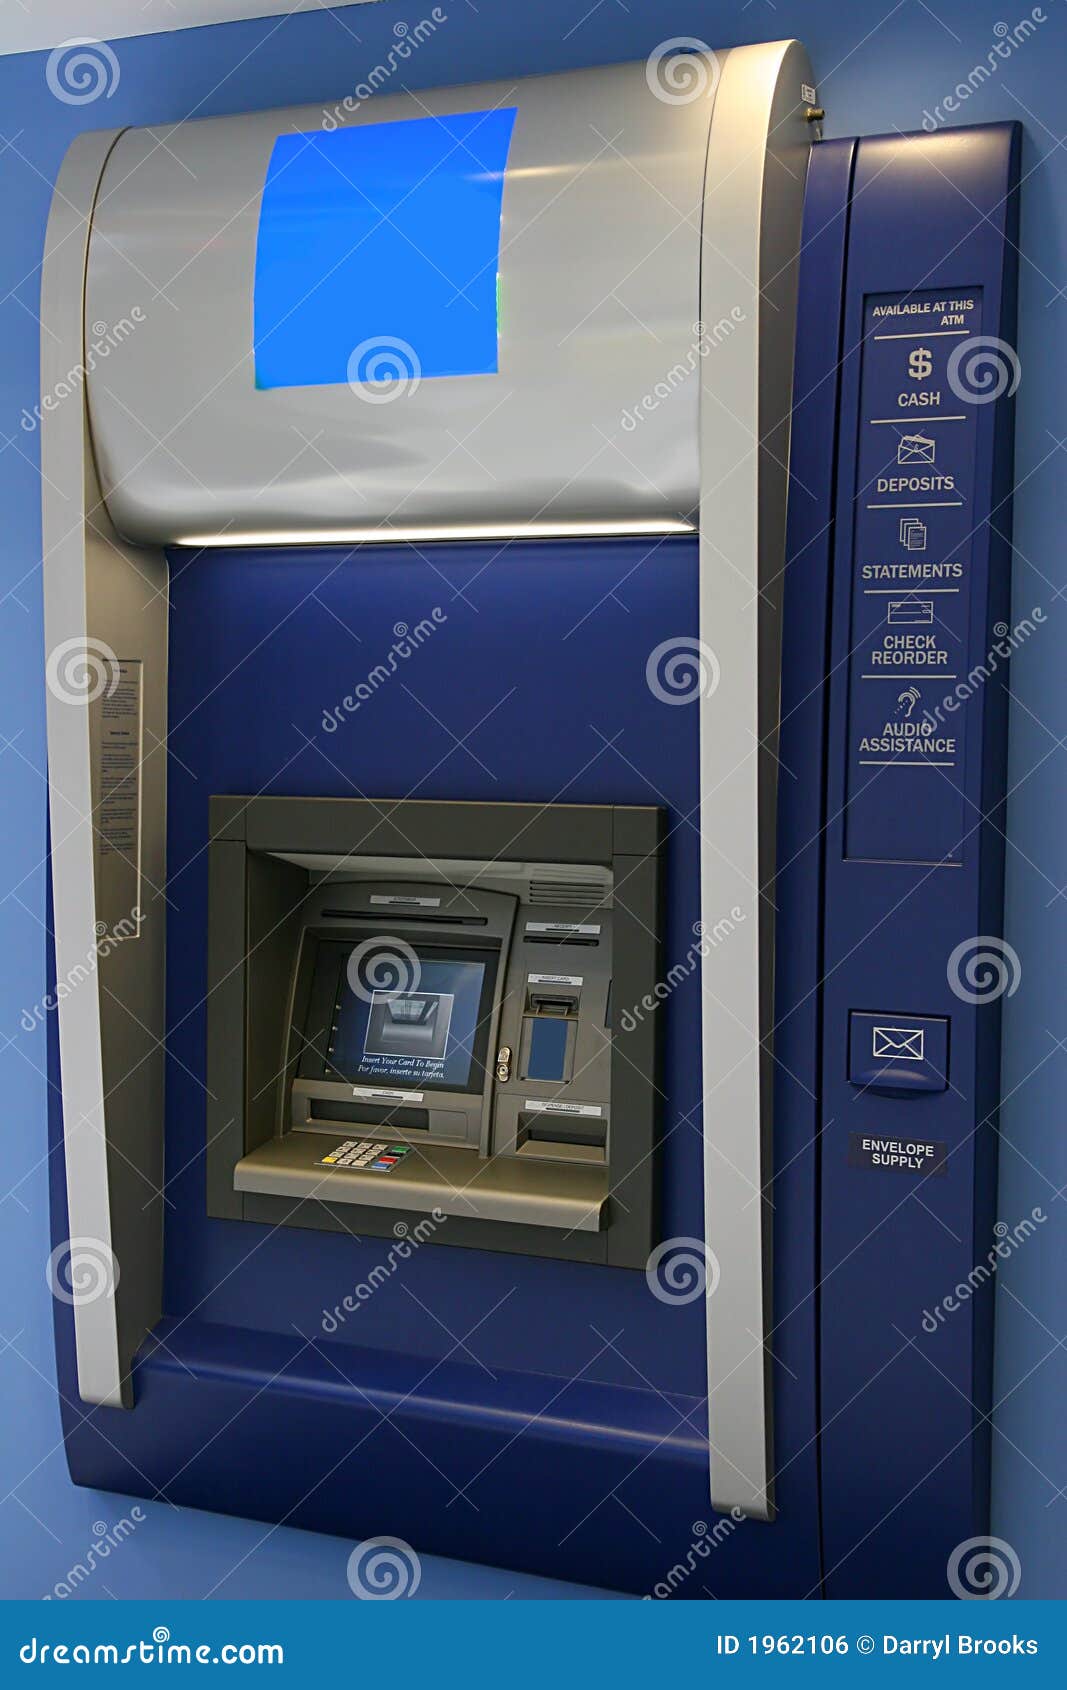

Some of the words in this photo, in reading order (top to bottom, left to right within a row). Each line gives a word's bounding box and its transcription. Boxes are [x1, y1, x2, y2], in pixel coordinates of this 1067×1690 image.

[872, 303, 931, 317] AVAILABLE
[932, 302, 947, 313] AT
[948, 300, 974, 311] THIS
[941, 315, 965, 326] ATM
[908, 347, 933, 380] $
[898, 391, 941, 407] CASH
[877, 476, 954, 492] DEPOSITS
[861, 563, 963, 579] STATEMENTS
[884, 635, 936, 649] CHECK
[872, 651, 948, 665] REORDER
[882, 723, 933, 736] AUDIO
[859, 738, 956, 753] ASSISTANCE
[361, 1055, 381, 1064] Insert
[381, 1057, 398, 1065] Your
[398, 1058, 415, 1067] Card
[415, 1059, 425, 1068] To
[862, 1139, 935, 1157] ENVELOPE
[872, 1153, 924, 1169] SUPPLY
